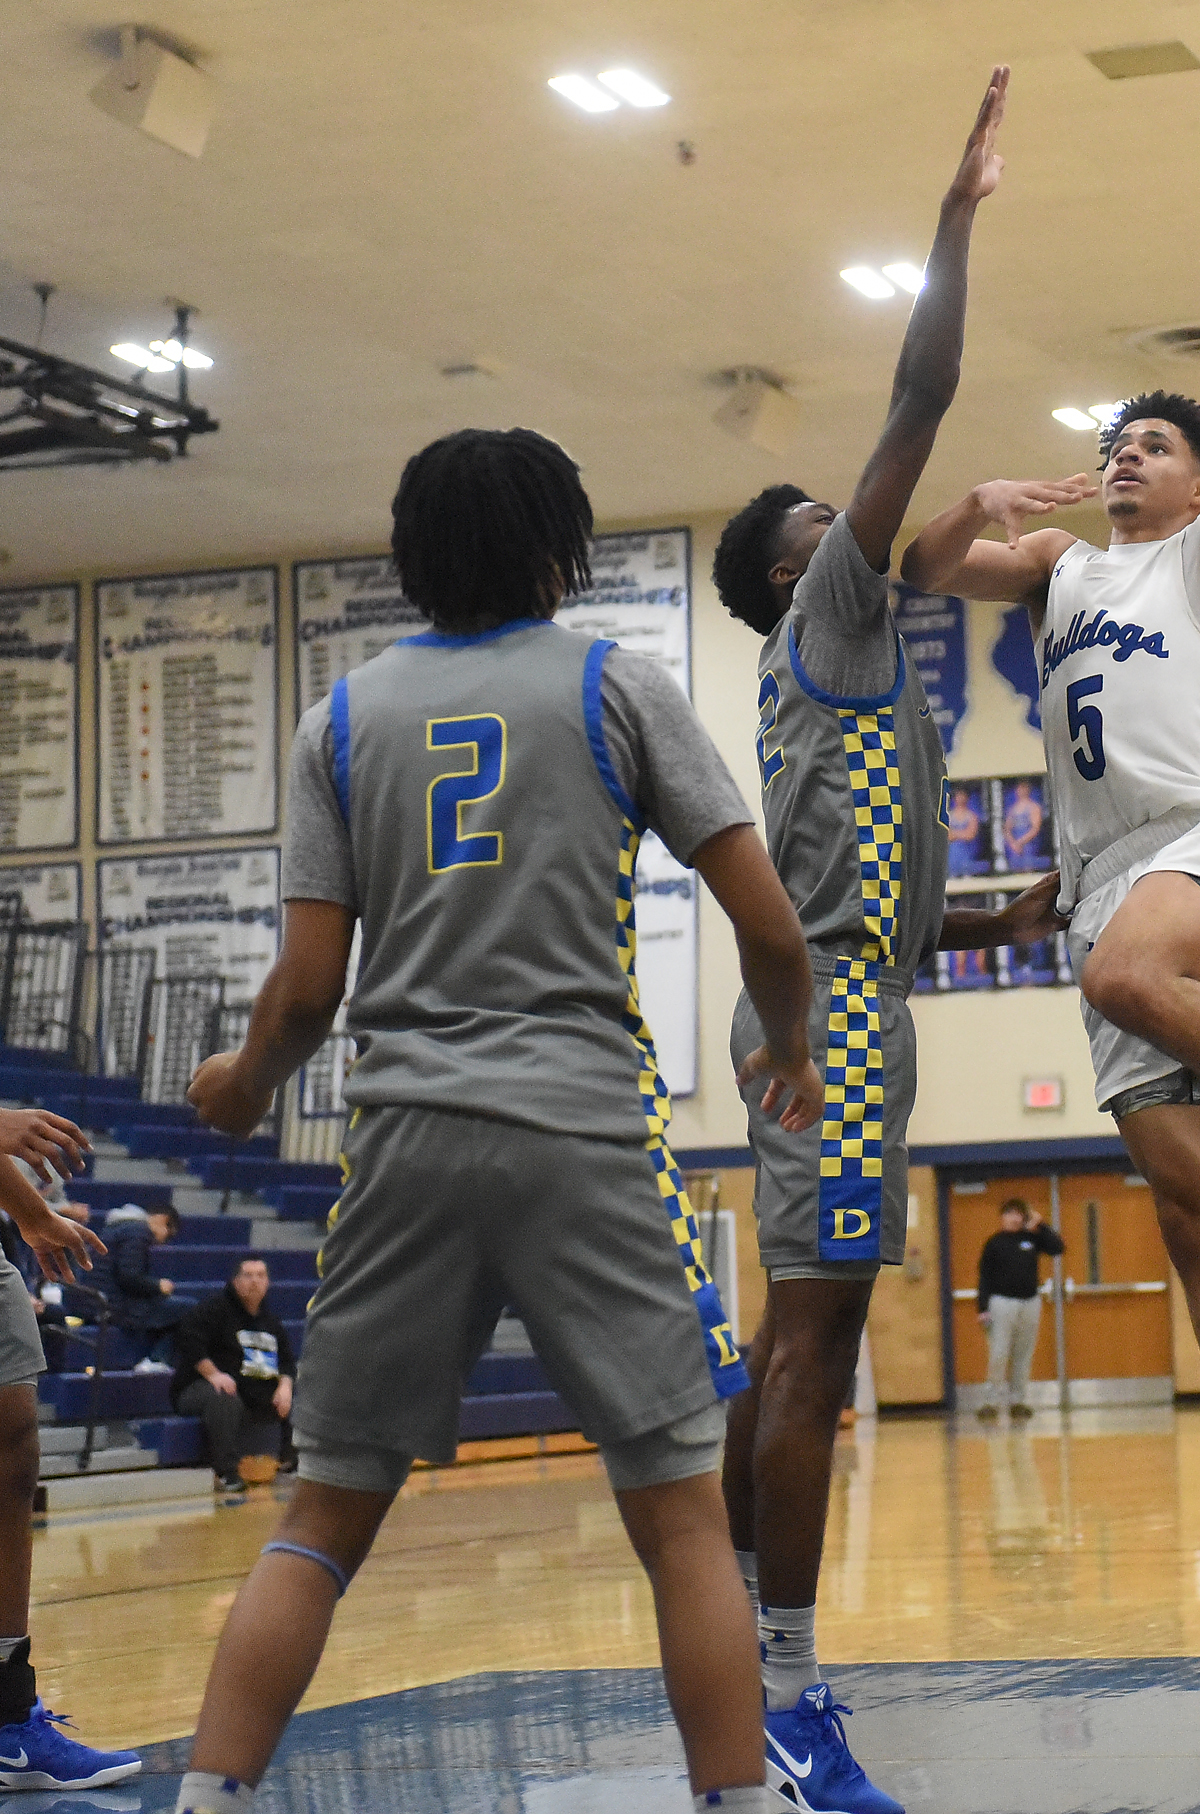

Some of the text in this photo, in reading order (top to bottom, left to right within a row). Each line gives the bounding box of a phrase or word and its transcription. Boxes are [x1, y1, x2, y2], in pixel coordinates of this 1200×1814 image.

[1066, 673, 1106, 781] 5
[426, 712, 507, 876] 2
[830, 1208, 871, 1239] D
